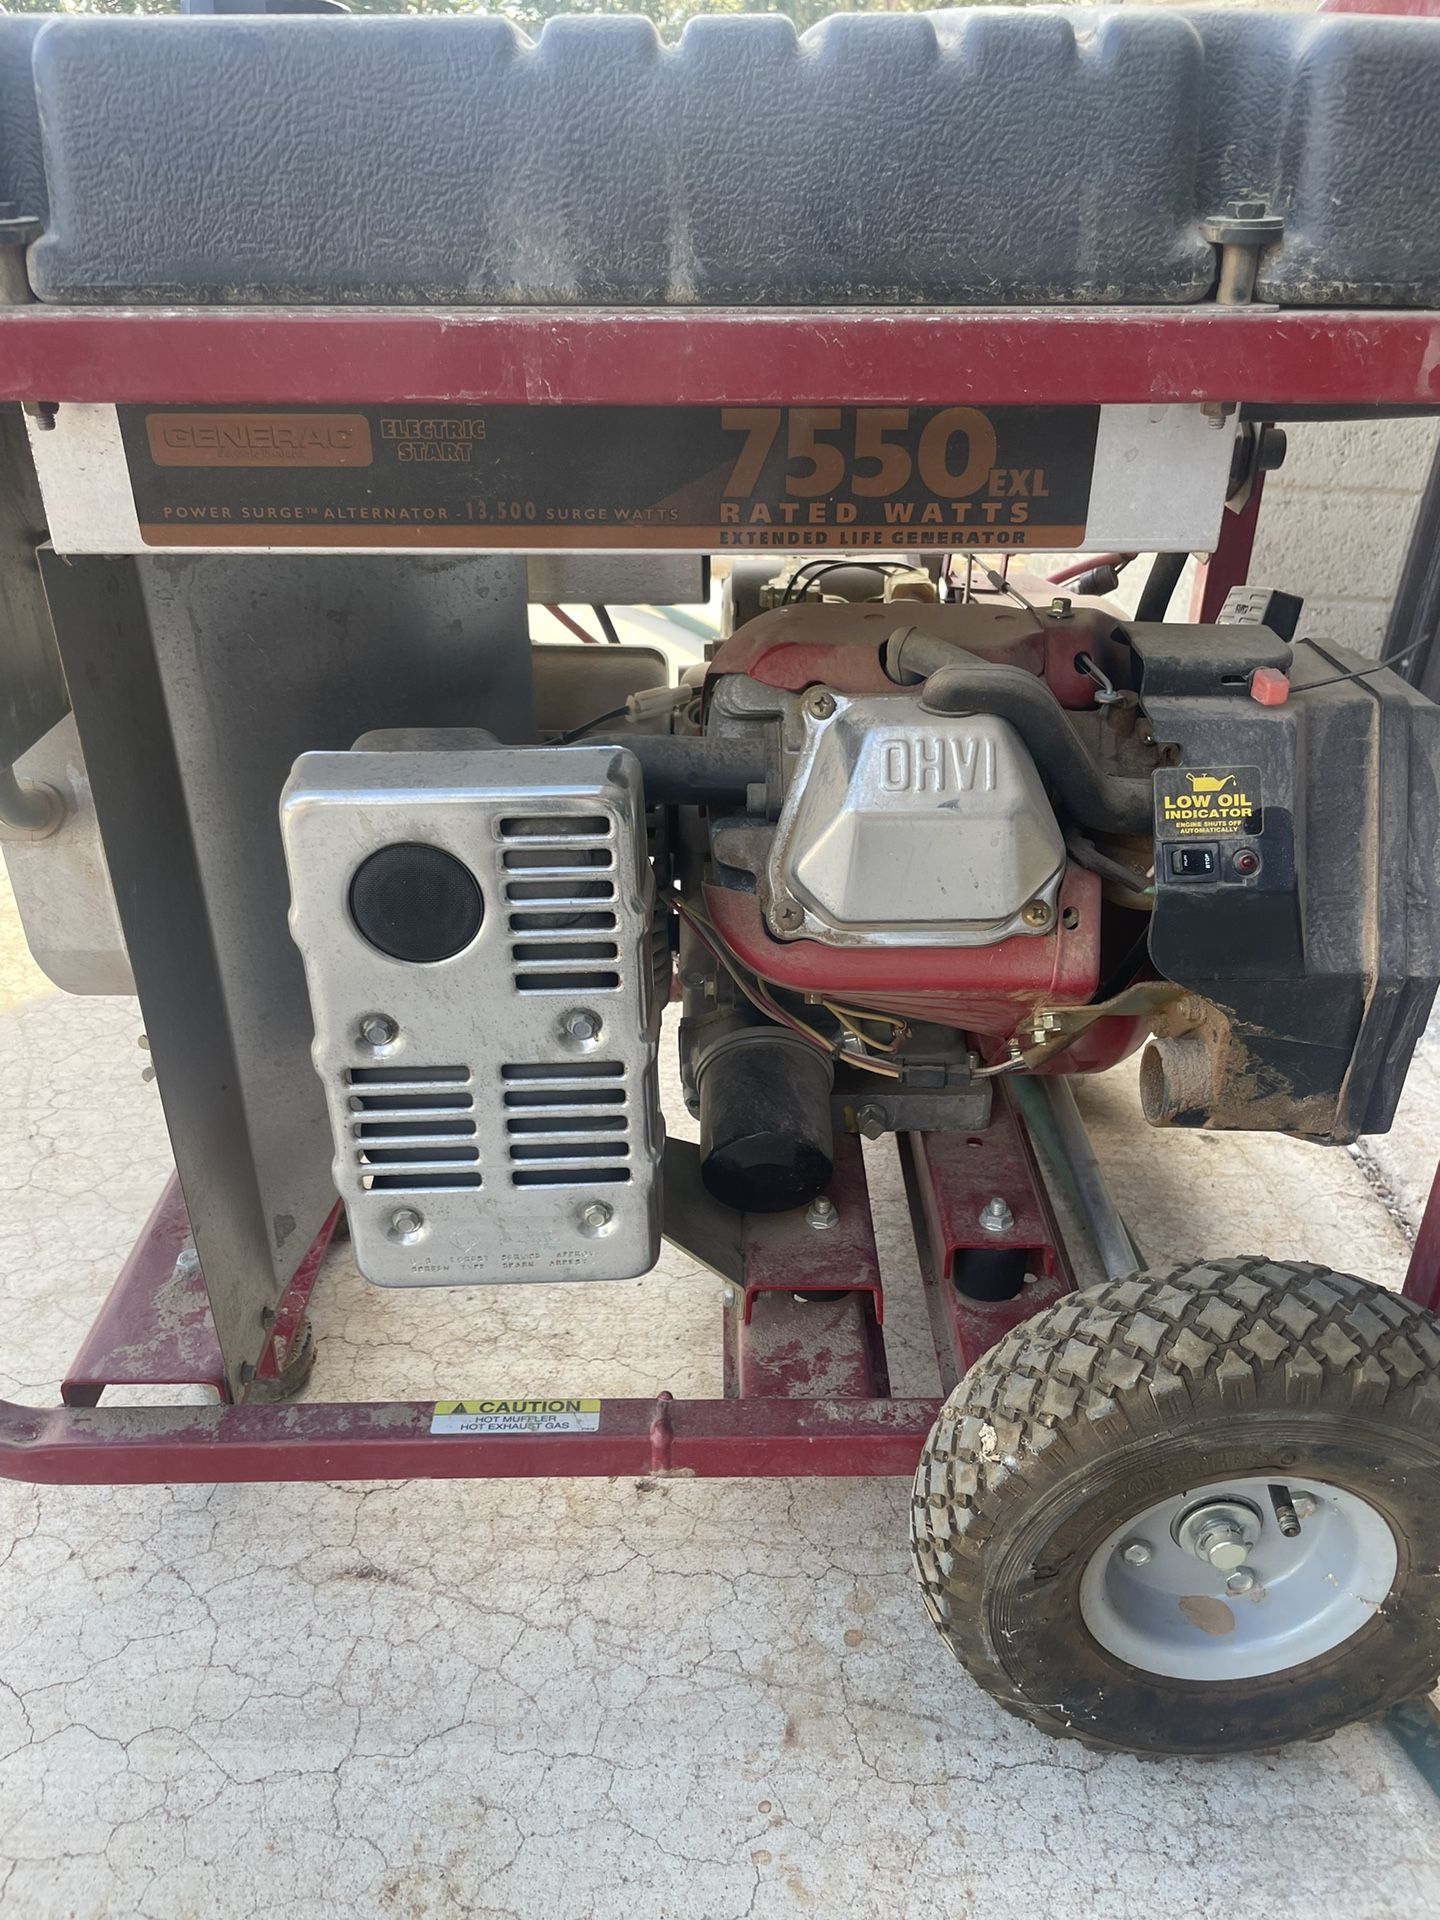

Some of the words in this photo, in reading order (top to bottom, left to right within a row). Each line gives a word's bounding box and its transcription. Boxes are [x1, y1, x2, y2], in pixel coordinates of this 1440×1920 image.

[162, 424, 354, 450] GENERAC
[380, 418, 487, 440] ELECTRIC
[397, 442, 473, 462] START
[720, 406, 997, 498] 7550
[988, 468, 1049, 497] EXL
[163, 506, 232, 519] POWER
[323, 506, 449, 520] ALTERNATOR
[466, 501, 537, 521] 13,500
[546, 508, 607, 521] SURGE
[614, 508, 679, 521] WATTS
[719, 502, 858, 523] RATED
[883, 502, 1029, 523] WATTS
[719, 531, 828, 545] EXTENDED
[840, 531, 883, 545] LIFE
[891, 531, 1026, 545] GENERATOR
[879, 738, 998, 792] OHVI
[1164, 795, 1211, 809] LOW
[1217, 793, 1252, 808] OIL
[1165, 808, 1253, 820] INDICATOR
[1180, 826, 1238, 834] AUTOMATICALLY
[479, 1400, 581, 1413] CAUTION
[460, 1423, 485, 1431] HOT
[488, 1422, 542, 1430] EXHAUST
[545, 1421, 570, 1430] GAS
[475, 1415, 500, 1423] HOT
[502, 1414, 557, 1423] MUFFLER
